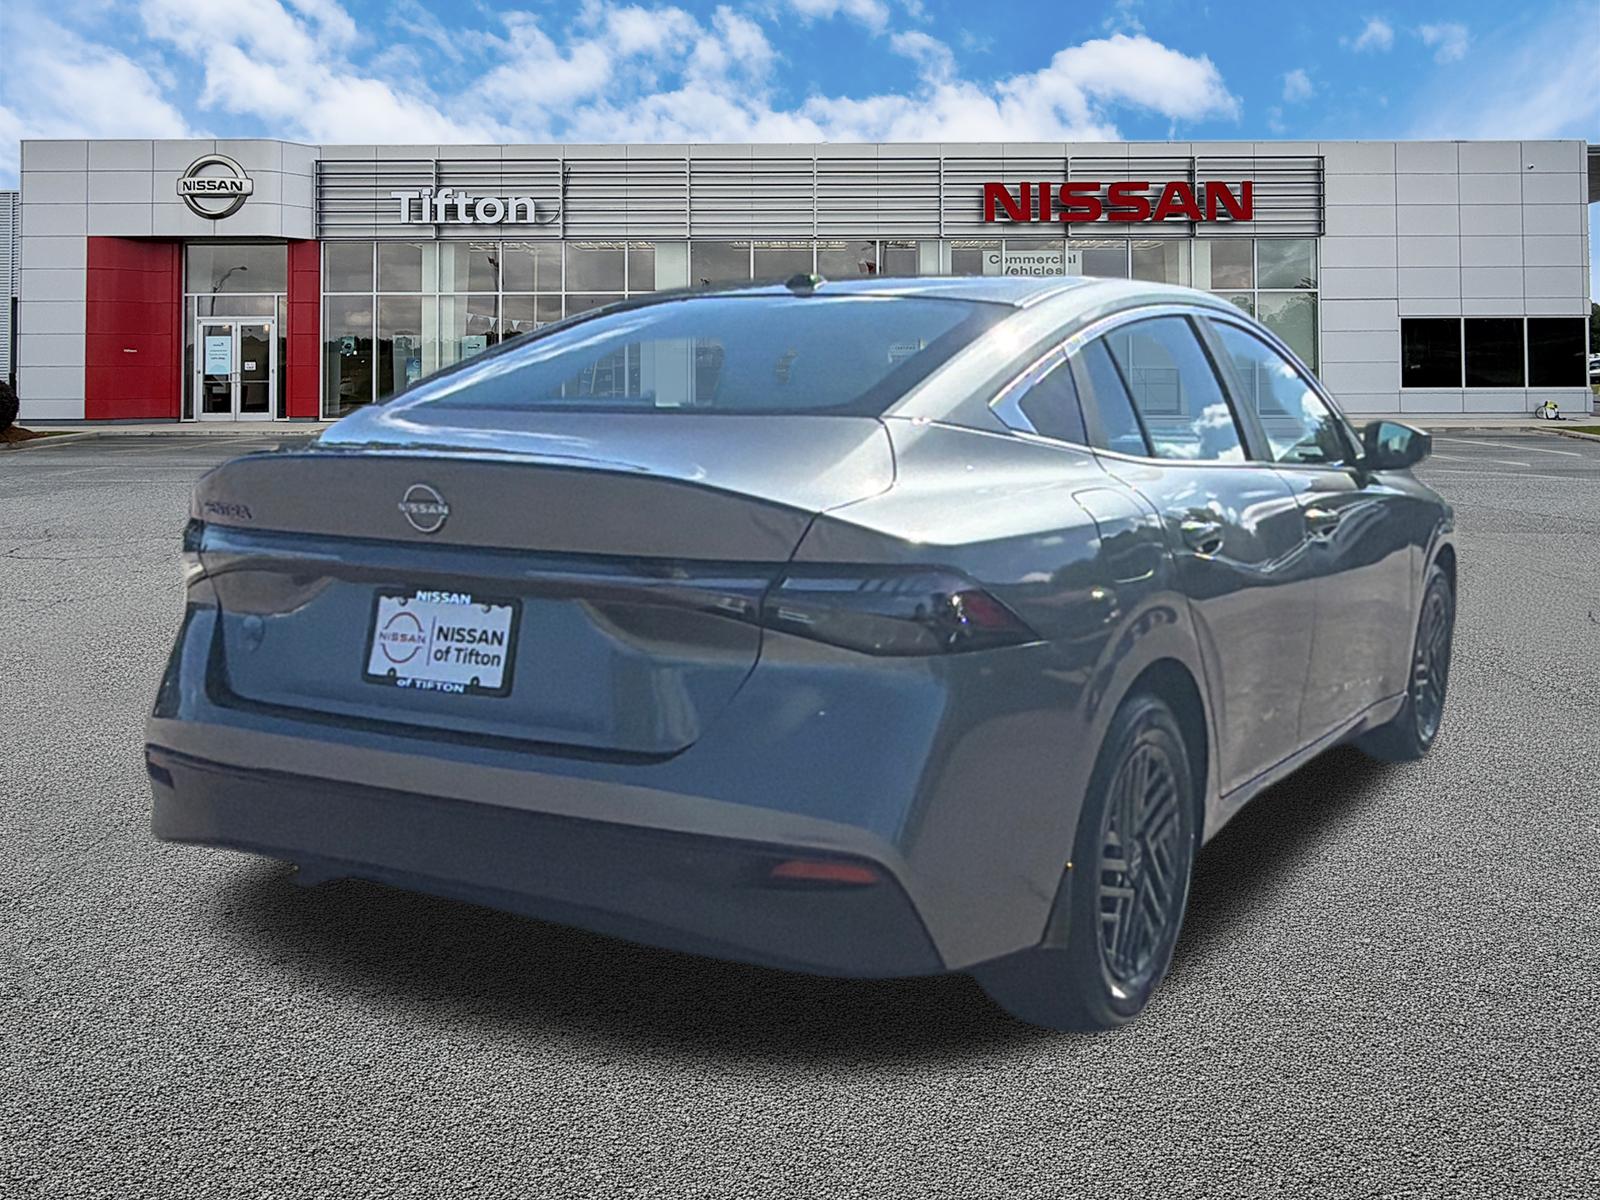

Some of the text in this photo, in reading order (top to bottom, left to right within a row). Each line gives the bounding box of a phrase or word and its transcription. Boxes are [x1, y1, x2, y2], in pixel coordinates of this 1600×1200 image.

[183, 180, 243, 191] NISSAN
[391, 188, 536, 224] Tifton
[983, 181, 1253, 222] NISSAN
[415, 590, 472, 605] NISSAN
[379, 631, 426, 644] NISSAN
[436, 625, 505, 646] NISSAN
[433, 646, 501, 667] of Tifton
[396, 679, 465, 694] of TIFTON
